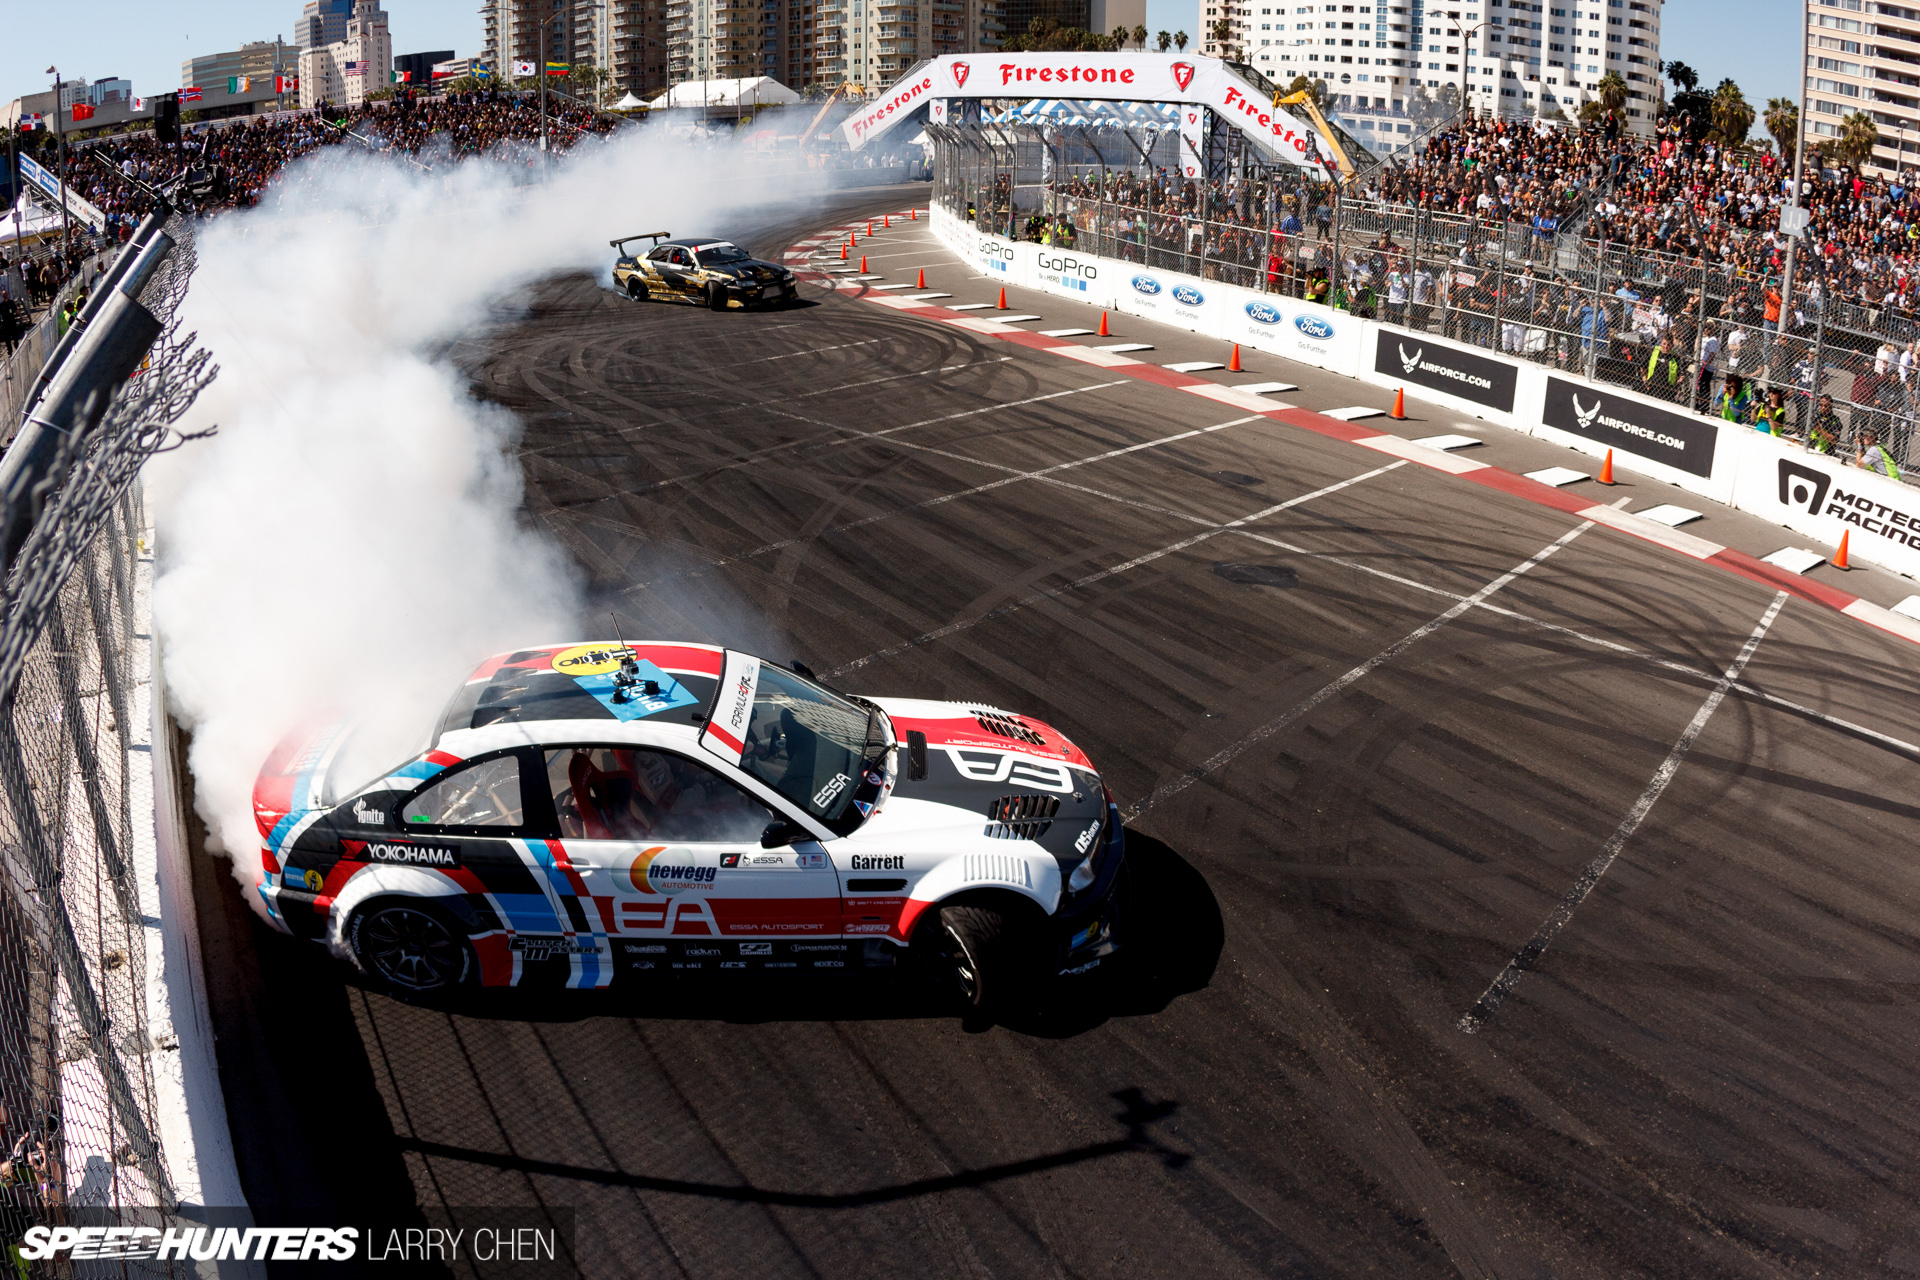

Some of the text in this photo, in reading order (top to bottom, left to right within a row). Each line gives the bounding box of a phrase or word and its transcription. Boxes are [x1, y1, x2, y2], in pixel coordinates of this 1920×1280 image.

[999, 63, 1135, 86] Firestone
[852, 78, 932, 138] Firestone
[1224, 87, 1337, 170] Firestoe
[1784, 211, 1802, 230] JJ
[979, 238, 1013, 260] GoPro
[1038, 252, 1097, 279] GoPro
[1136, 276, 1156, 293] Ford
[1141, 299, 1157, 308] Further
[1177, 286, 1198, 304] Ford
[1182, 310, 1199, 320] Further
[1250, 303, 1275, 322] Ford
[1256, 329, 1275, 339] Further
[1300, 317, 1327, 337] Ford
[1298, 341, 1327, 355] Go Further
[1419, 361, 1492, 389] AIRFORCE.COM
[1597, 415, 1685, 450] AIRFORCE.COM
[1826, 503, 1920, 551] RACING
[945, 738, 1066, 760] ESSA AUTOSPORT
[813, 773, 851, 808] ESSA
[367, 843, 455, 865] YOKOHAMA
[851, 854, 904, 870] Garrett
[648, 864, 717, 882] newegg
[661, 882, 715, 890] AUTOMOTIVE
[686, 948, 721, 956] radium
